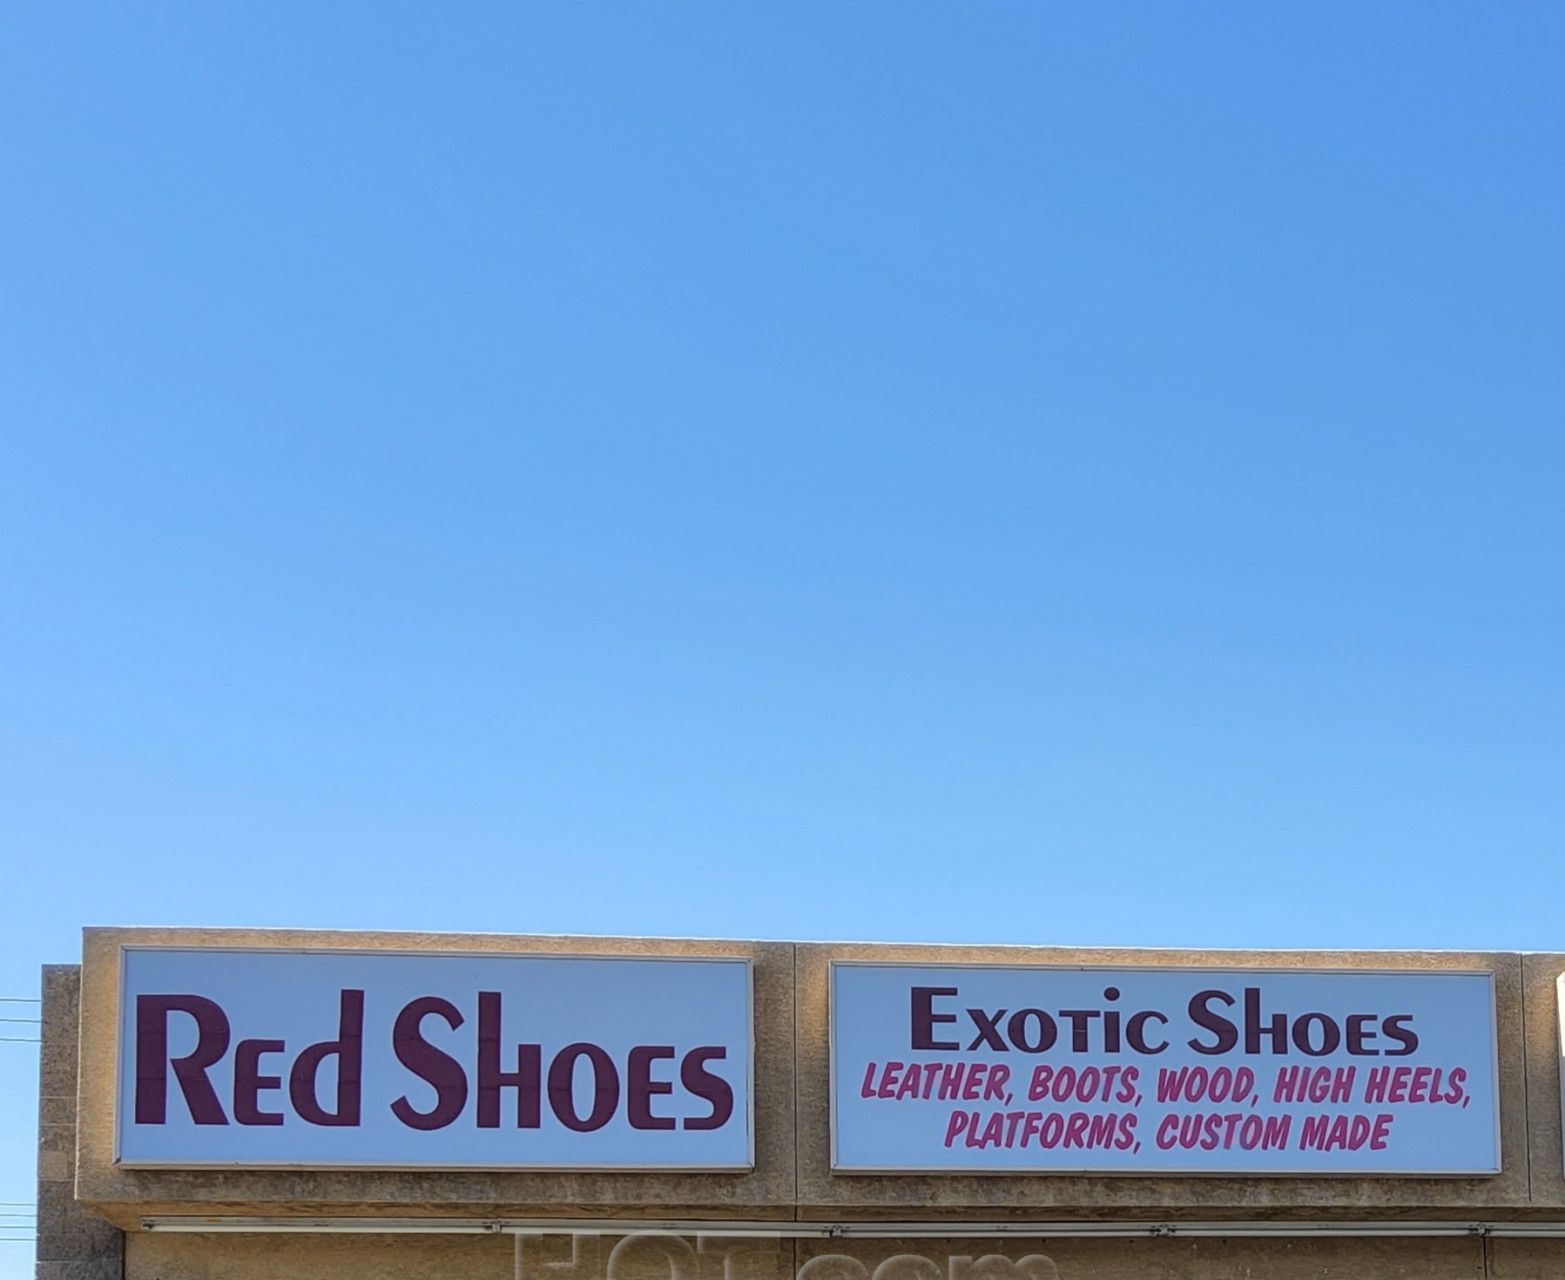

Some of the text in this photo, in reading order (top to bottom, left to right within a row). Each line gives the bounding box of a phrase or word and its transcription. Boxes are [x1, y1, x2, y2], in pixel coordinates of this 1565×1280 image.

[910, 986, 1419, 1056] Exotic Shoes
[134, 989, 734, 1132] Red Shoes
[861, 1062, 1471, 1110] LEATHER, BOOTS, WOOD, HIGH HEELS,
[944, 1111, 1394, 1155] PLATFORMS, CUSTOM MADE
